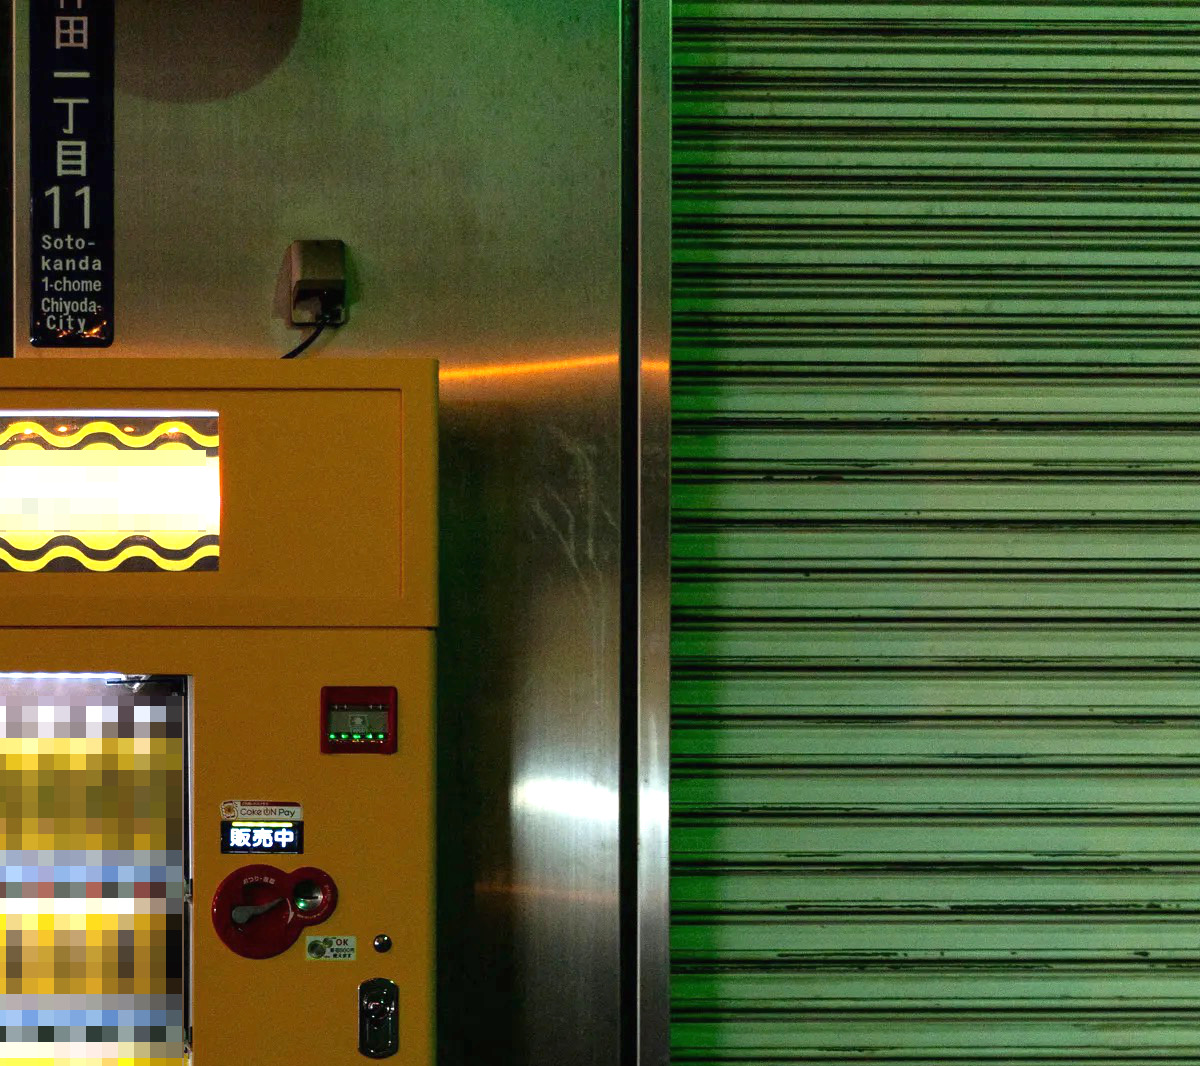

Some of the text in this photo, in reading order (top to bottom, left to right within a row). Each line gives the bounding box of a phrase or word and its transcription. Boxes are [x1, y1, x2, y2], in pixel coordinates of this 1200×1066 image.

[53, 0, 91, 177] 田一丁目
[44, 185, 91, 229] 11
[41, 234, 96, 250] Soto-
[41, 255, 102, 271] kanda
[41, 276, 102, 292] 1-chome
[46, 315, 86, 334] City
[240, 808, 262, 816] Coke
[278, 808, 296, 818] Pay
[229, 827, 295, 848] 販売中
[335, 938, 349, 946] OK
